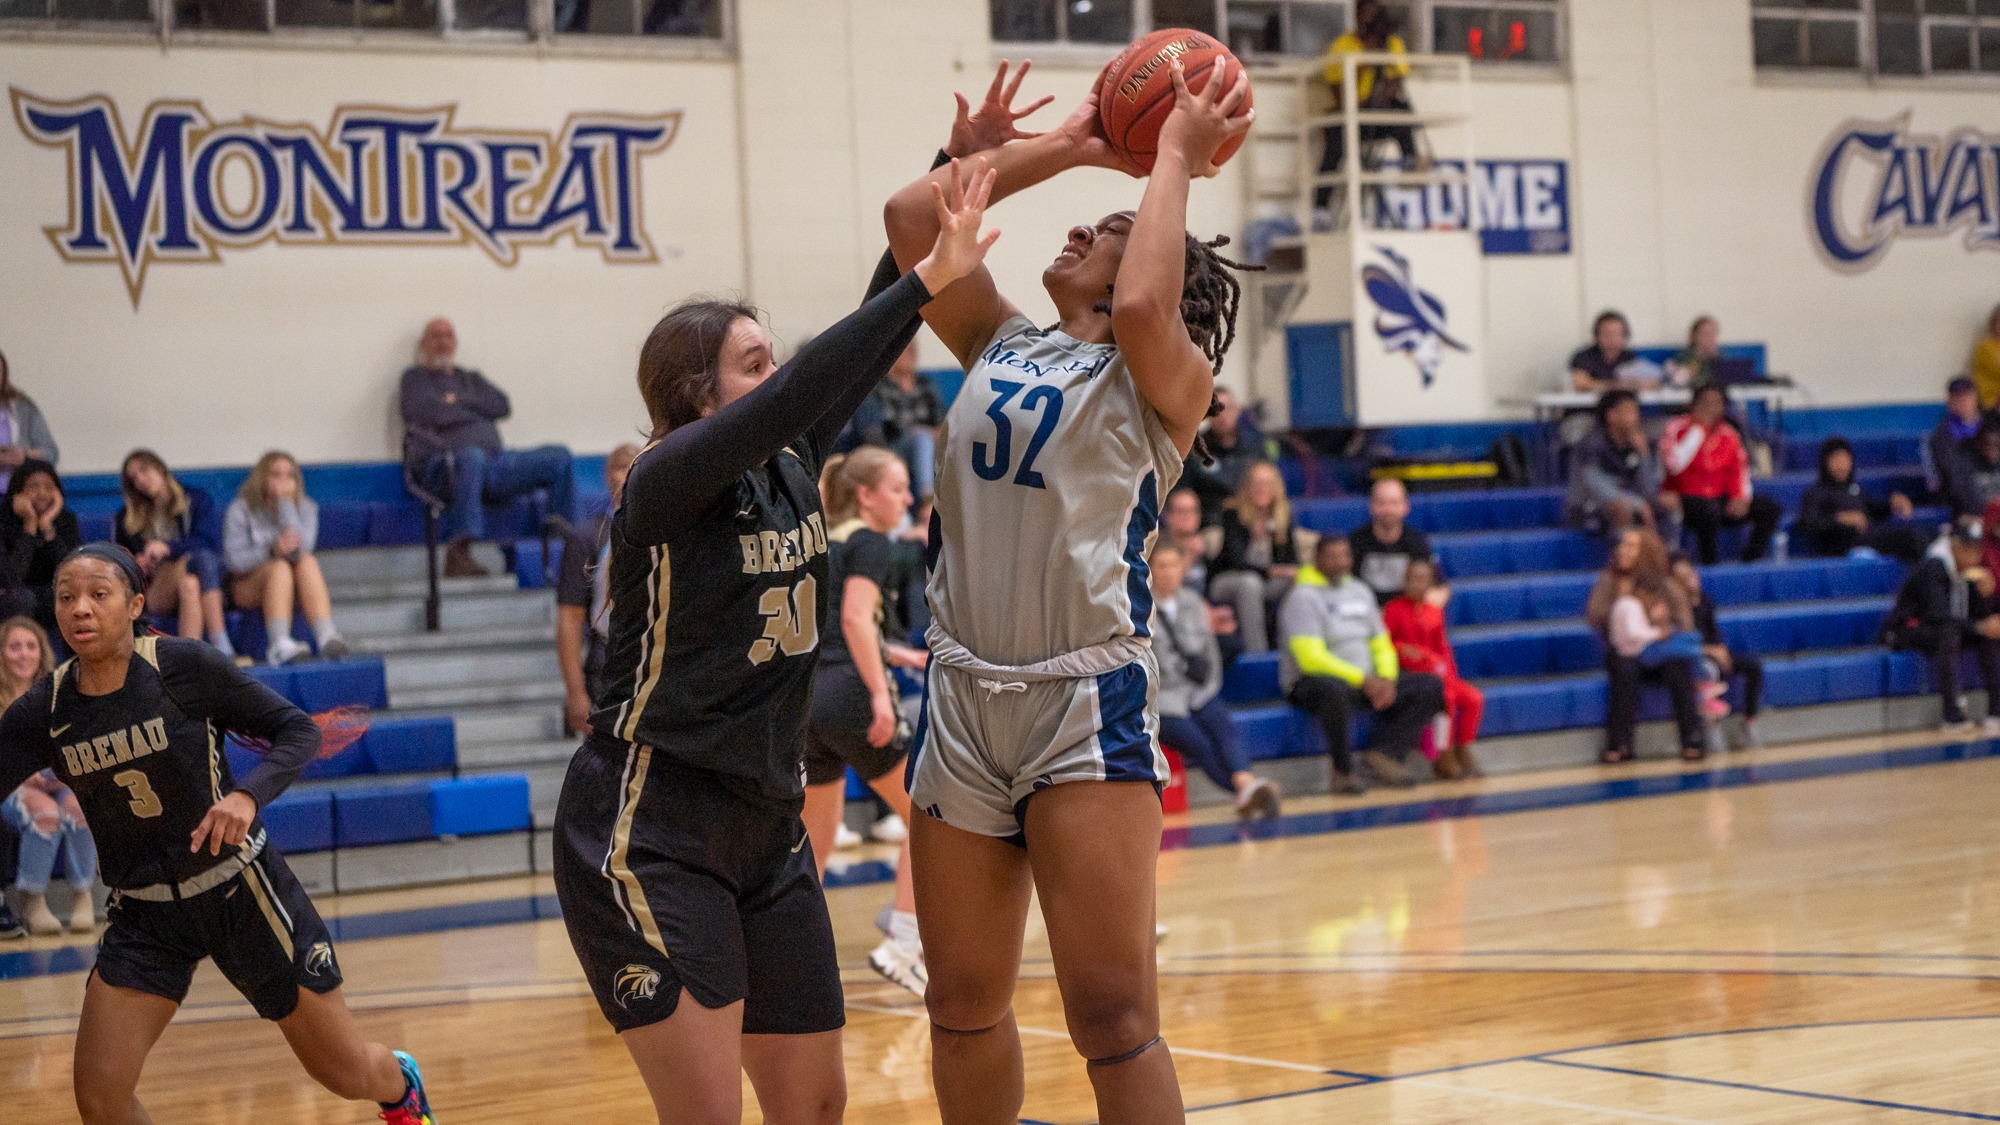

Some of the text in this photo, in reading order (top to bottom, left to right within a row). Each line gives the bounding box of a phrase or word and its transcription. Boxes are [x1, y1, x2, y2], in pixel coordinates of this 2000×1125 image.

[1118, 33, 1212, 103] SPALDING
[18, 98, 672, 270] MONTREAT
[1810, 125, 2000, 264] CAVA
[971, 377, 1064, 490] 32
[747, 572, 819, 667] 30
[61, 716, 169, 777] BRENAU
[113, 768, 164, 819] 3
